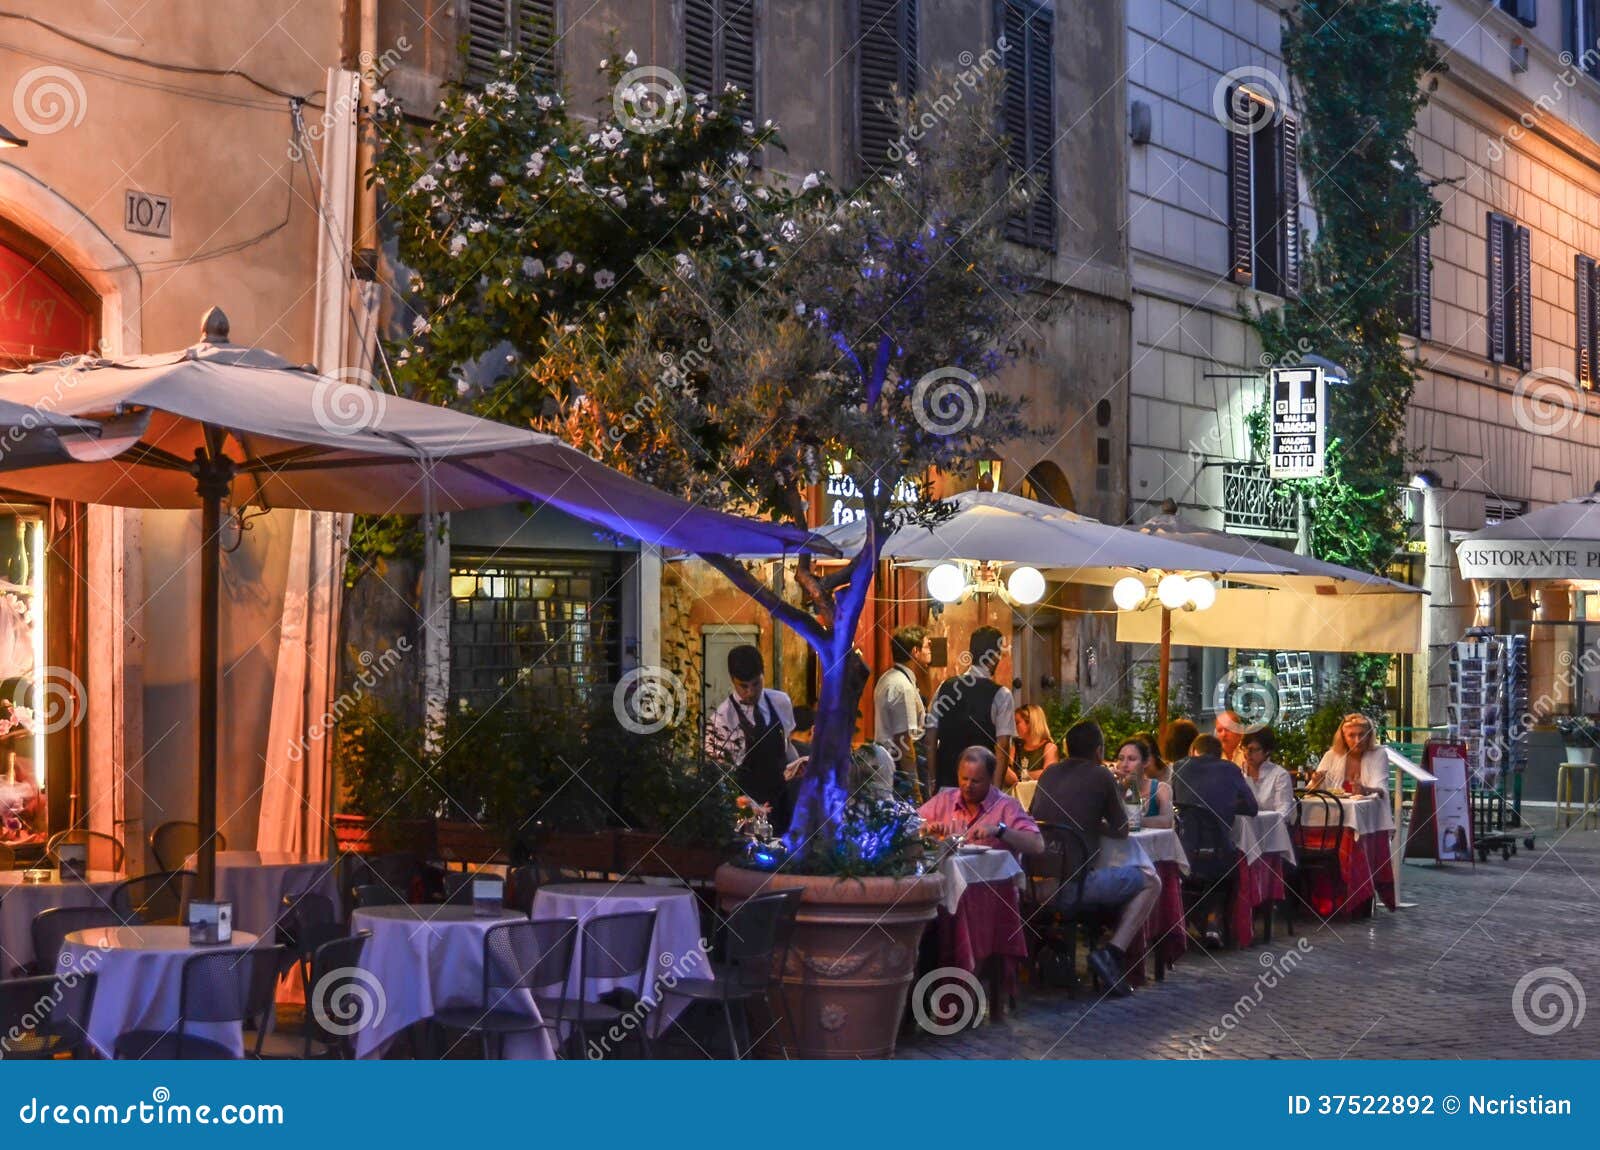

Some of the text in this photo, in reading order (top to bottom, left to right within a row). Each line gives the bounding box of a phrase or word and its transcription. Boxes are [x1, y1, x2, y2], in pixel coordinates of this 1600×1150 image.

[128, 196, 167, 229] 107
[1279, 371, 1311, 414] T
[1274, 422, 1315, 433] TABACCHI
[1281, 437, 1309, 445] VALORI
[1279, 445, 1311, 453] BOLLATI
[1275, 455, 1314, 467] LOTTO
[1465, 550, 1577, 567] RISTORANTE
